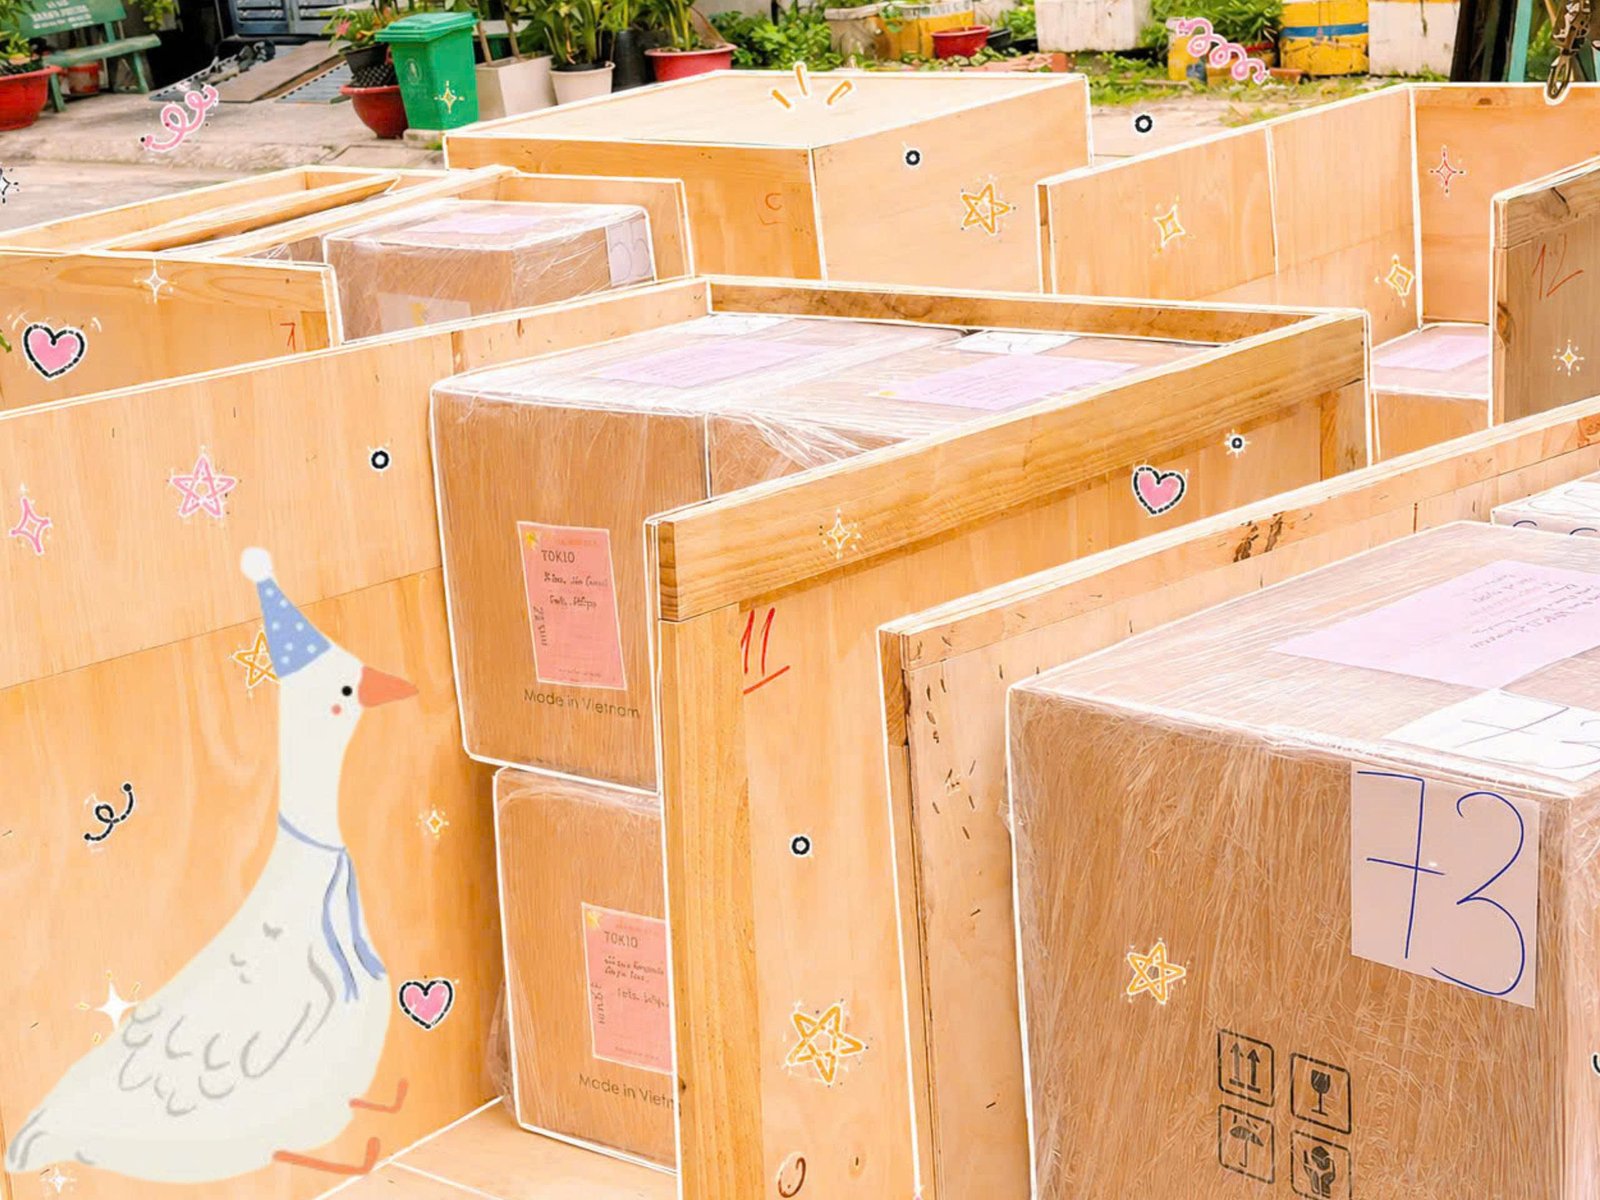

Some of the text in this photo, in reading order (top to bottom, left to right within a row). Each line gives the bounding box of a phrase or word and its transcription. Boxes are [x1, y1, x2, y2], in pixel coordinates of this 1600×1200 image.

[541, 549, 575, 564] TOKIO
[523, 688, 640, 719] Made in Vietnam
[1356, 770, 1526, 997] 73
[604, 930, 639, 948] TOKIO
[579, 1073, 620, 1095] Made
[623, 1083, 636, 1099] in
